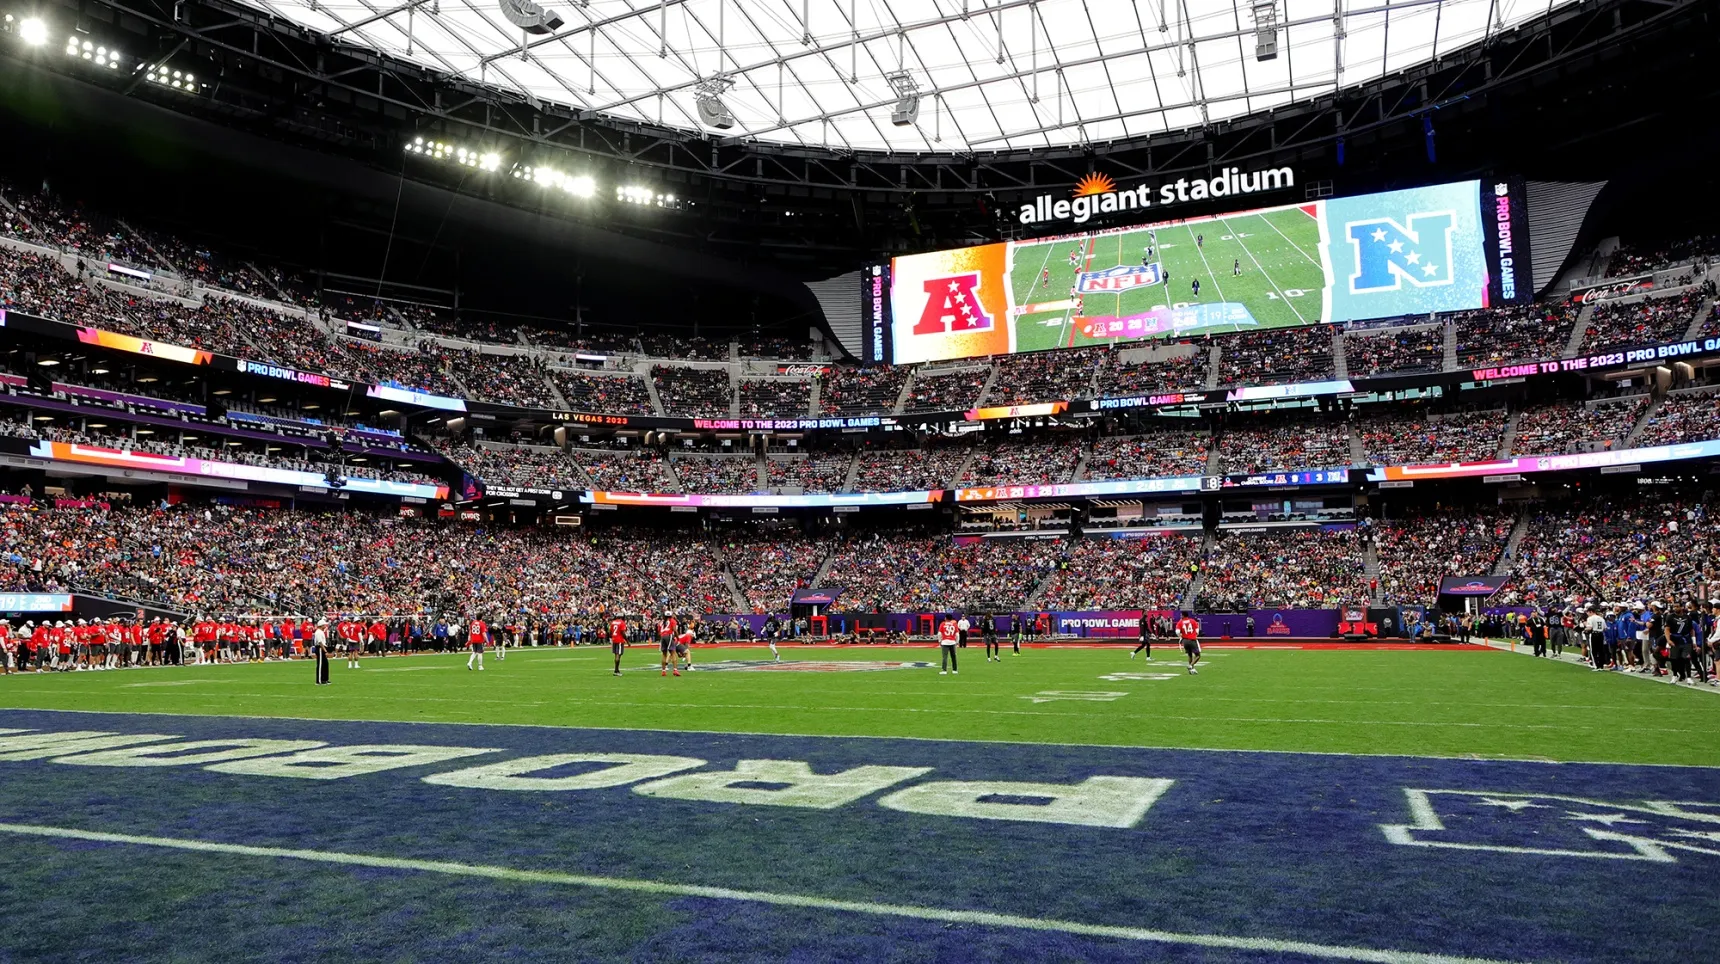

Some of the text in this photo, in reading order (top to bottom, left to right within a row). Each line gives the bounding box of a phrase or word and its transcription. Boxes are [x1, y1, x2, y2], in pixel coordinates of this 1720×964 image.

[1019, 166, 1294, 223] allegiant stadium
[1496, 196, 1515, 300] PRO BOWL GAMES
[1087, 274, 1152, 290] NFL
[873, 276, 883, 361] PRO BOWL GAMES
[1473, 364, 1538, 381] WELCOME
[1540, 362, 1559, 373] TO
[1561, 358, 1587, 371] THE
[1590, 353, 1624, 367] 2023
[1626, 348, 1656, 362] PRO
[1658, 341, 1702, 358] BOWL
[248, 362, 330, 387] PRO BOWL GAMES
[1100, 394, 1184, 409] PRO BOWL GAMES
[552, 412, 628, 425] LAS VEGAS 2023
[693, 420, 740, 429] WELCOME
[741, 420, 754, 429] TO
[755, 420, 773, 429] THE
[774, 420, 798, 429] 2023
[799, 420, 818, 429] PRO
[819, 419, 846, 428] BOWL
[847, 417, 880, 427] GAMES
[1209, 477, 1218, 489] 8
[1316, 473, 1323, 481] 3
[1136, 480, 1164, 491] 2:45
[1010, 487, 1024, 497] 20
[471, 624, 481, 635] 88
[1061, 619, 1081, 628] PRO
[1111, 619, 1140, 628] GAME
[1182, 623, 1194, 634] 14
[1676, 622, 1685, 634] 7
[613, 625, 619, 636] 2
[944, 624, 956, 636] 39
[420, 752, 1175, 828] PRO
